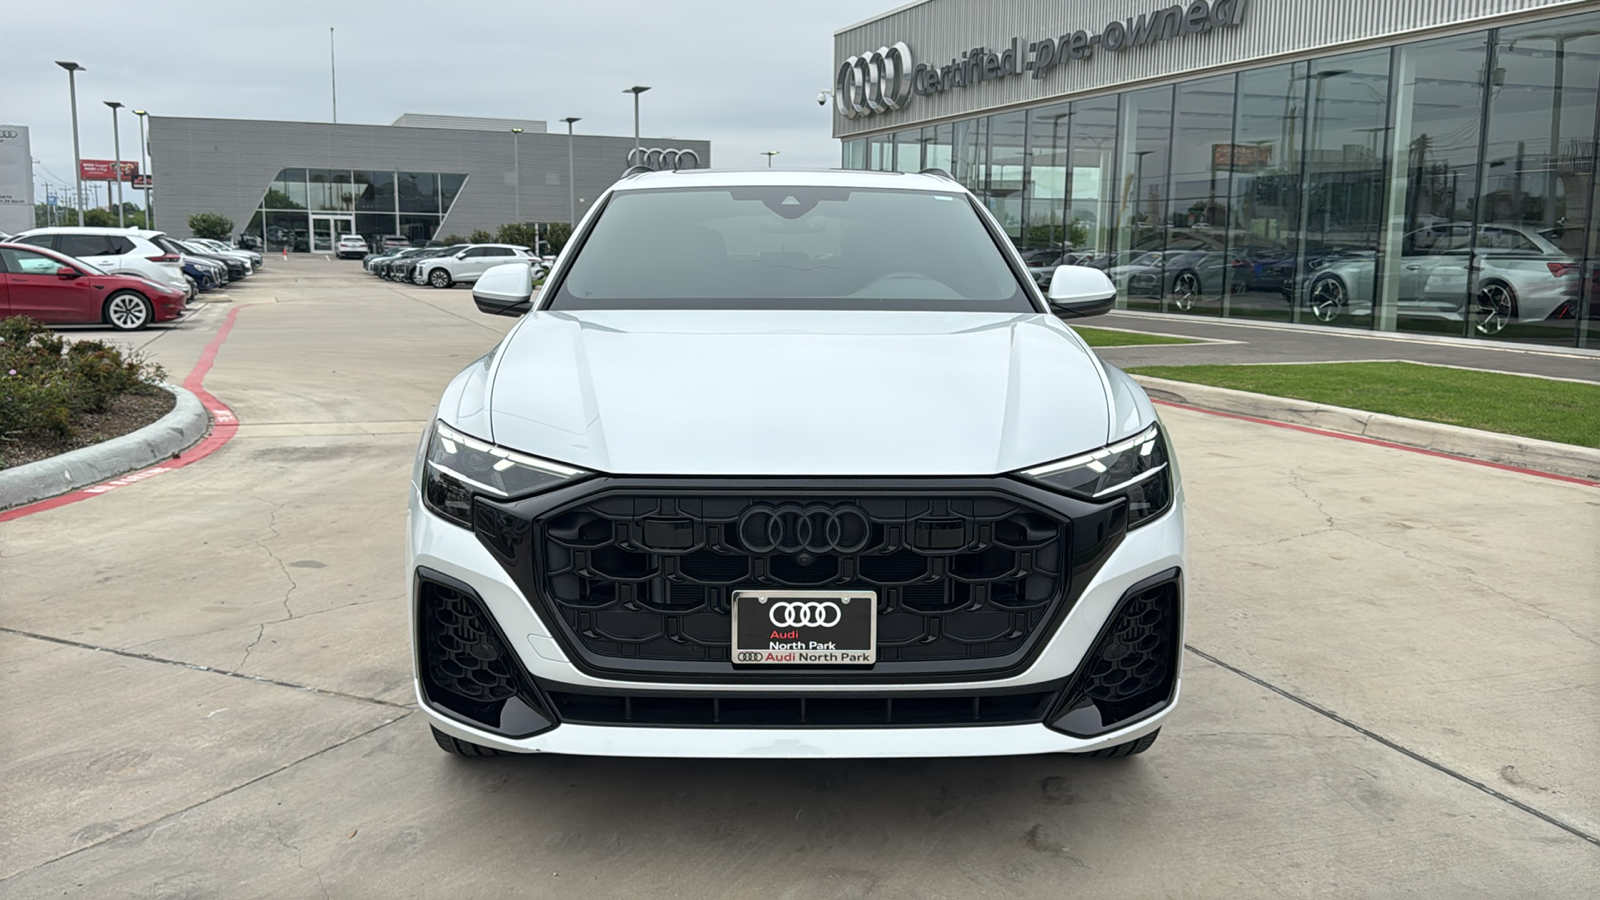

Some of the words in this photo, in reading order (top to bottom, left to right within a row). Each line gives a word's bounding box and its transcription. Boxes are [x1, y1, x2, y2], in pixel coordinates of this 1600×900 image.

[912, 37, 1022, 96] Certified
[770, 630, 799, 639] Audi
[769, 641, 806, 650] North
[809, 641, 836, 650] Park
[765, 652, 796, 662] Audi
[799, 652, 838, 662] North
[841, 652, 870, 662] Park
